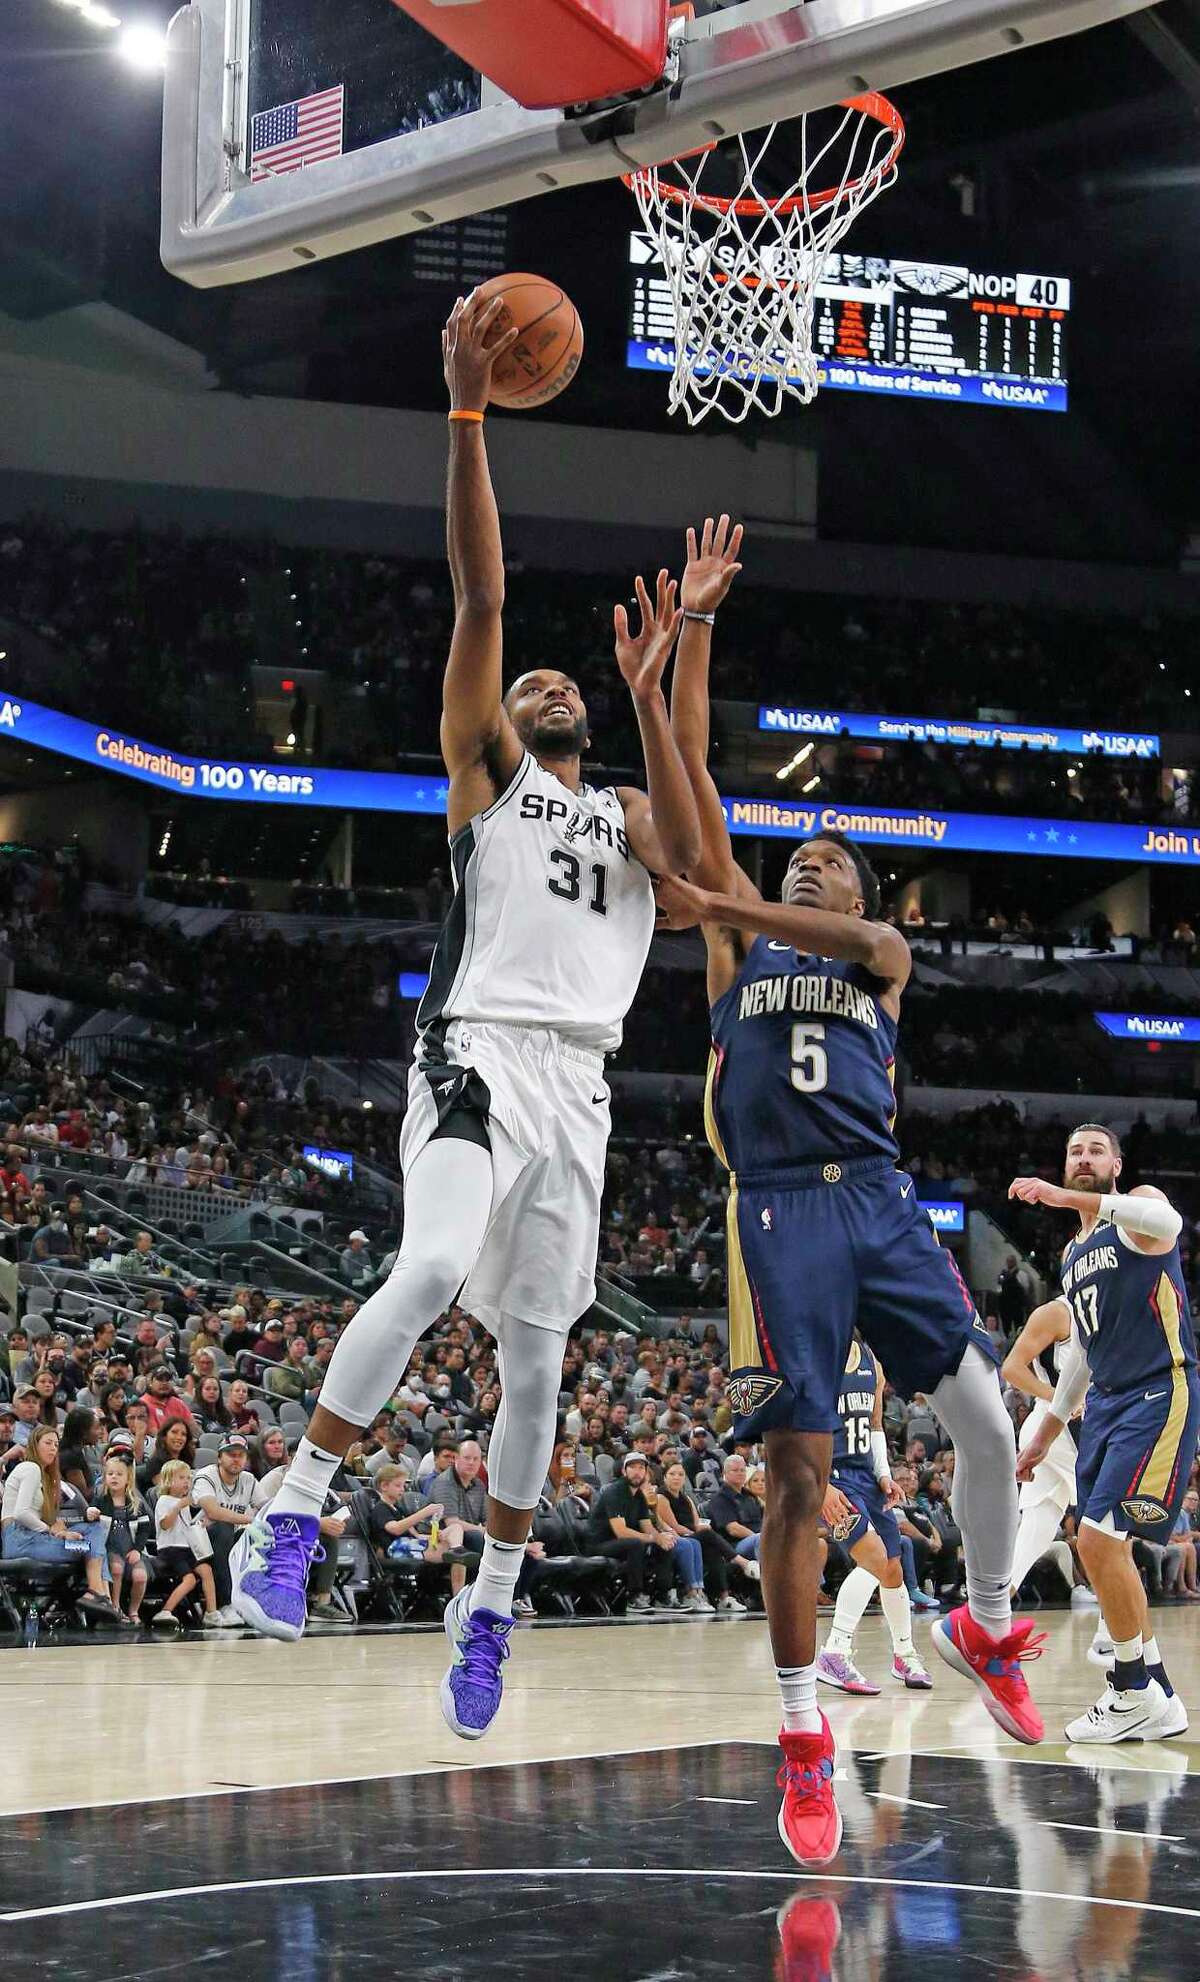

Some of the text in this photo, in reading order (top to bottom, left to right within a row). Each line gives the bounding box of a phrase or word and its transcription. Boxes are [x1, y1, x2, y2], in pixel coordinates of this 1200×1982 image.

[969, 273, 1058, 305] NOP 40
[829, 368, 856, 384] 100
[857, 371, 894, 389] Years
[895, 375, 910, 391] of
[911, 376, 962, 396] Service
[879, 721, 924, 737] Serving
[926, 724, 946, 737] the
[948, 726, 990, 741] Military
[993, 730, 1058, 746] Community
[96, 733, 313, 795] Celebrating 100 Years
[520, 794, 629, 862] SPURS
[733, 803, 816, 831] Military
[821, 809, 947, 841] Community
[1142, 831, 1188, 853] Join
[546, 848, 609, 918] 31
[738, 975, 878, 1030] NEW ORLEANS
[790, 1023, 828, 1093] 5
[927, 1208, 954, 1223] SAA
[1074, 1246, 1118, 1282] ORLEANS
[1074, 1284, 1099, 1336] 17
[844, 1417, 871, 1455] 15
